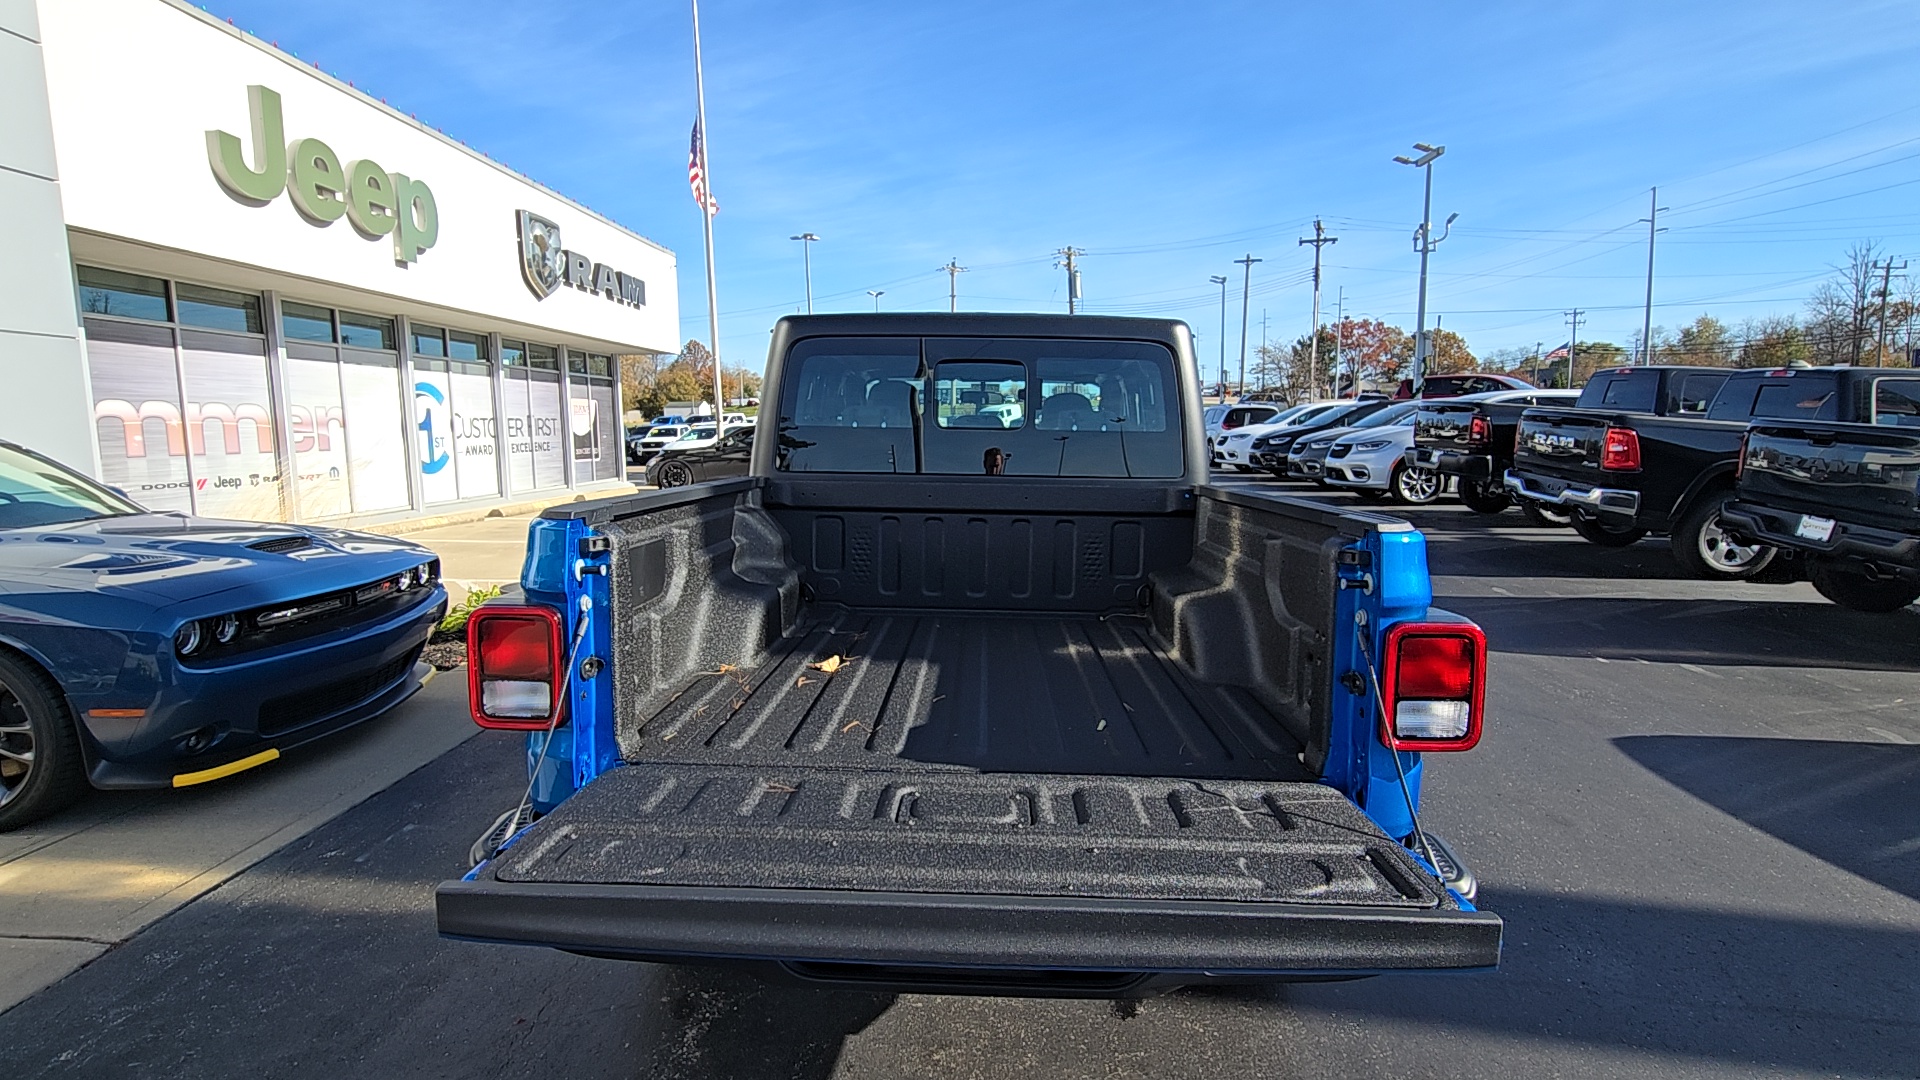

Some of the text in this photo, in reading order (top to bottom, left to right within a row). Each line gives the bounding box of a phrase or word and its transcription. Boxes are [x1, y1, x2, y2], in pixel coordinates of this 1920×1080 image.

[205, 85, 438, 263] Jeep
[563, 250, 646, 307] RAM
[1534, 432, 1575, 448] RAM
[465, 441, 550, 456] AWARD EXCELENCE
[1778, 454, 1860, 475] RAM
[141, 482, 191, 491] DODG
[213, 475, 242, 489] Jeep
